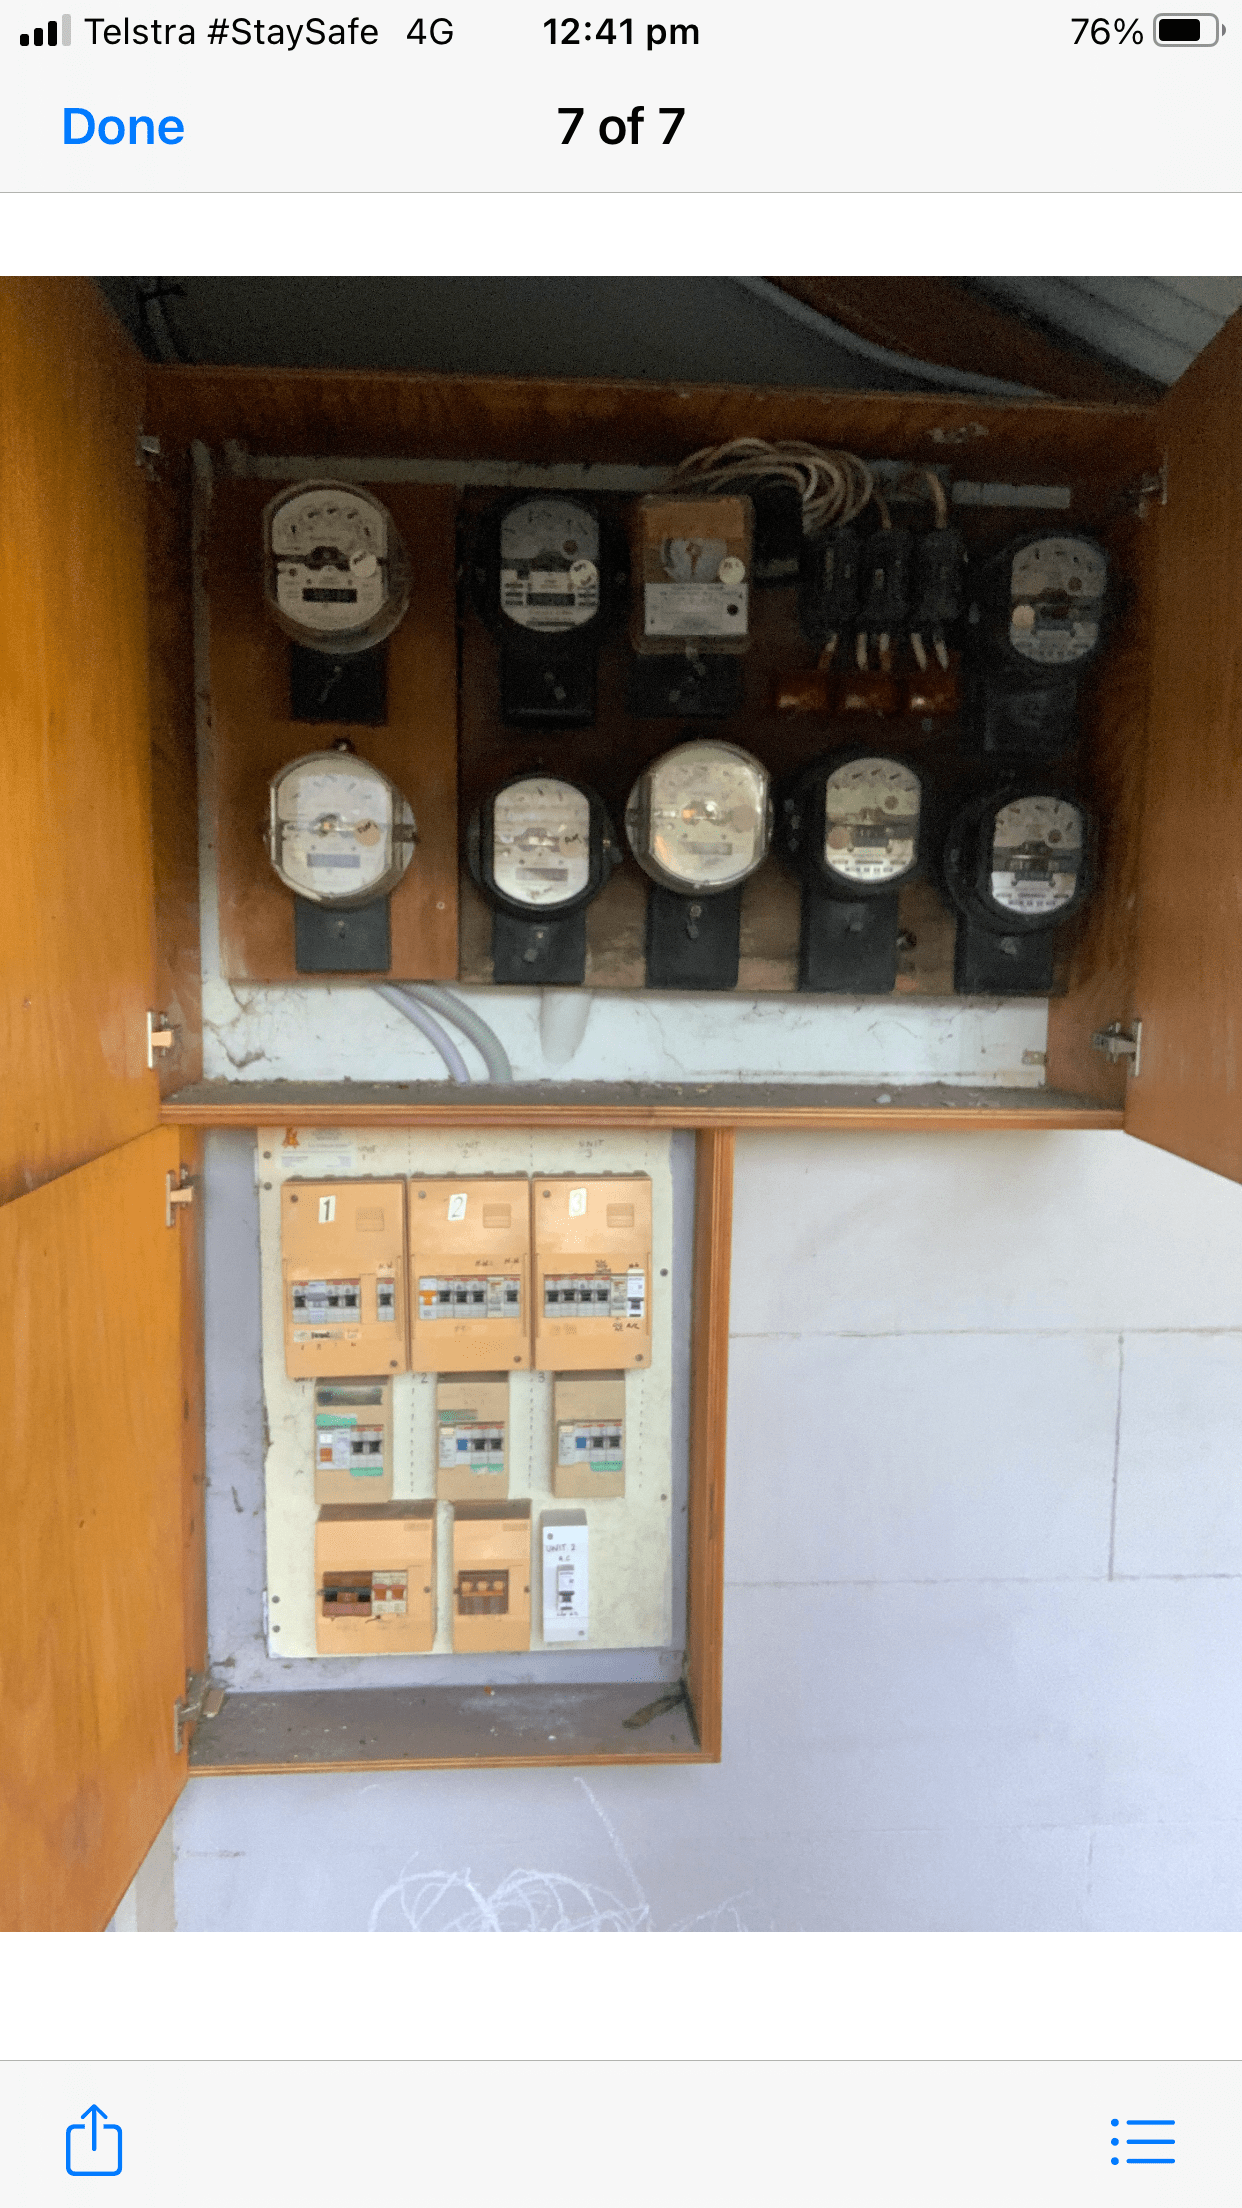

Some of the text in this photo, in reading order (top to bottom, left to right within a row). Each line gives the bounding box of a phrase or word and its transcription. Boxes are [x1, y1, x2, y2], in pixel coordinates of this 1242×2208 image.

[84, 16, 379, 52] Telstra #StaySafe
[406, 17, 454, 46] 4G
[543, 17, 700, 52] 12:41 pm
[1070, 17, 1144, 46] 76%
[63, 107, 185, 146] Done
[557, 105, 686, 146] 7 of 7
[577, 1139, 605, 1148] UNIT
[584, 1148, 593, 1159] 3
[323, 1198, 332, 1222] 1
[450, 1195, 465, 1219] 2
[571, 1191, 584, 1214] 3
[420, 1372, 429, 1384] 2
[537, 1371, 546, 1384] 3
[545, 1543, 567, 1553] UNIT
